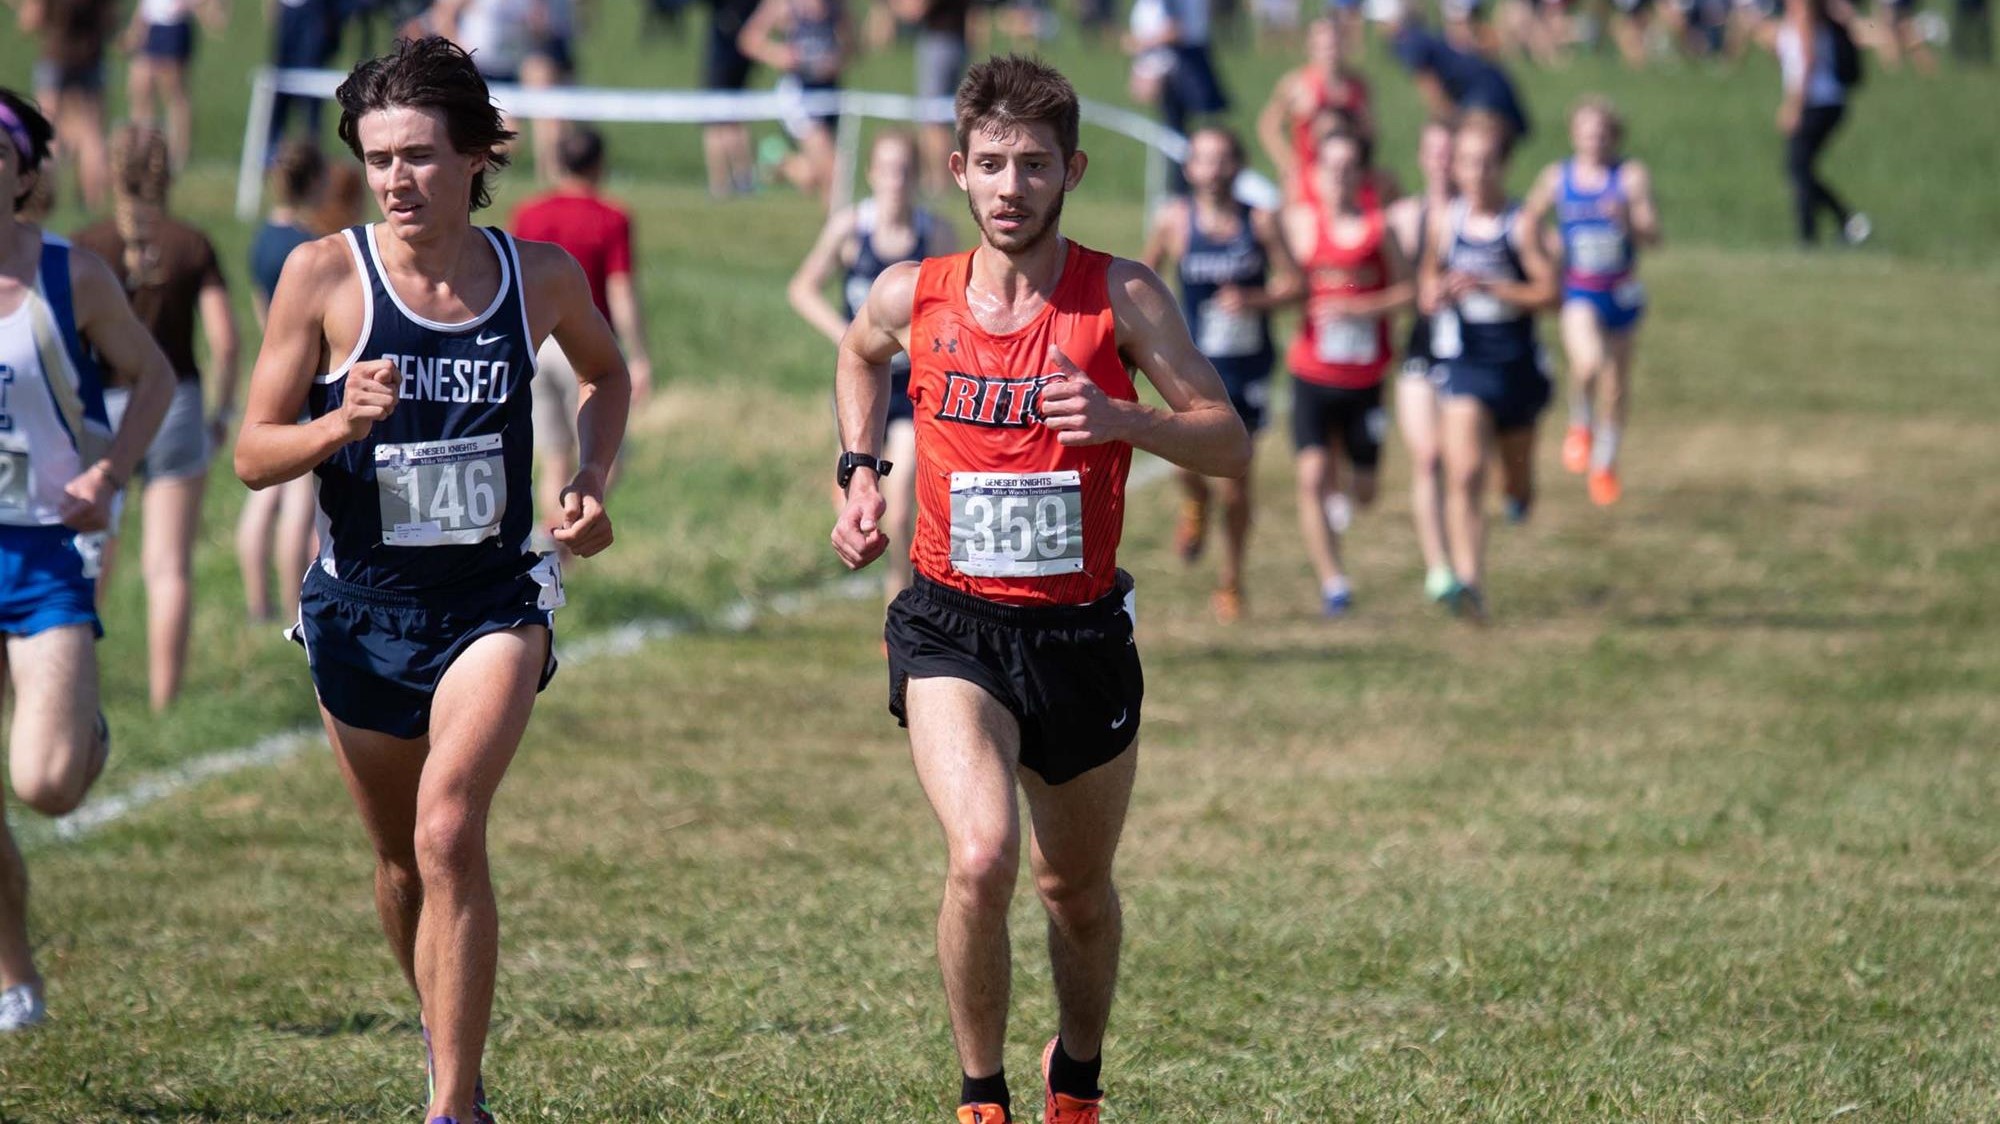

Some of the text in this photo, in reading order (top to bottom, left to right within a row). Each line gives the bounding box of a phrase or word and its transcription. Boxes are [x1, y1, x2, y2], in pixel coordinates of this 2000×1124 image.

[940, 374, 1036, 424] RIT
[413, 442, 478, 457] GENESEO KNIGHTS
[397, 459, 495, 528] 146
[985, 477, 1051, 487] GENESEO KNIGHTS
[992, 488, 1008, 496] Mike
[1008, 488, 1028, 496] Woods
[965, 495, 1067, 560] 359
